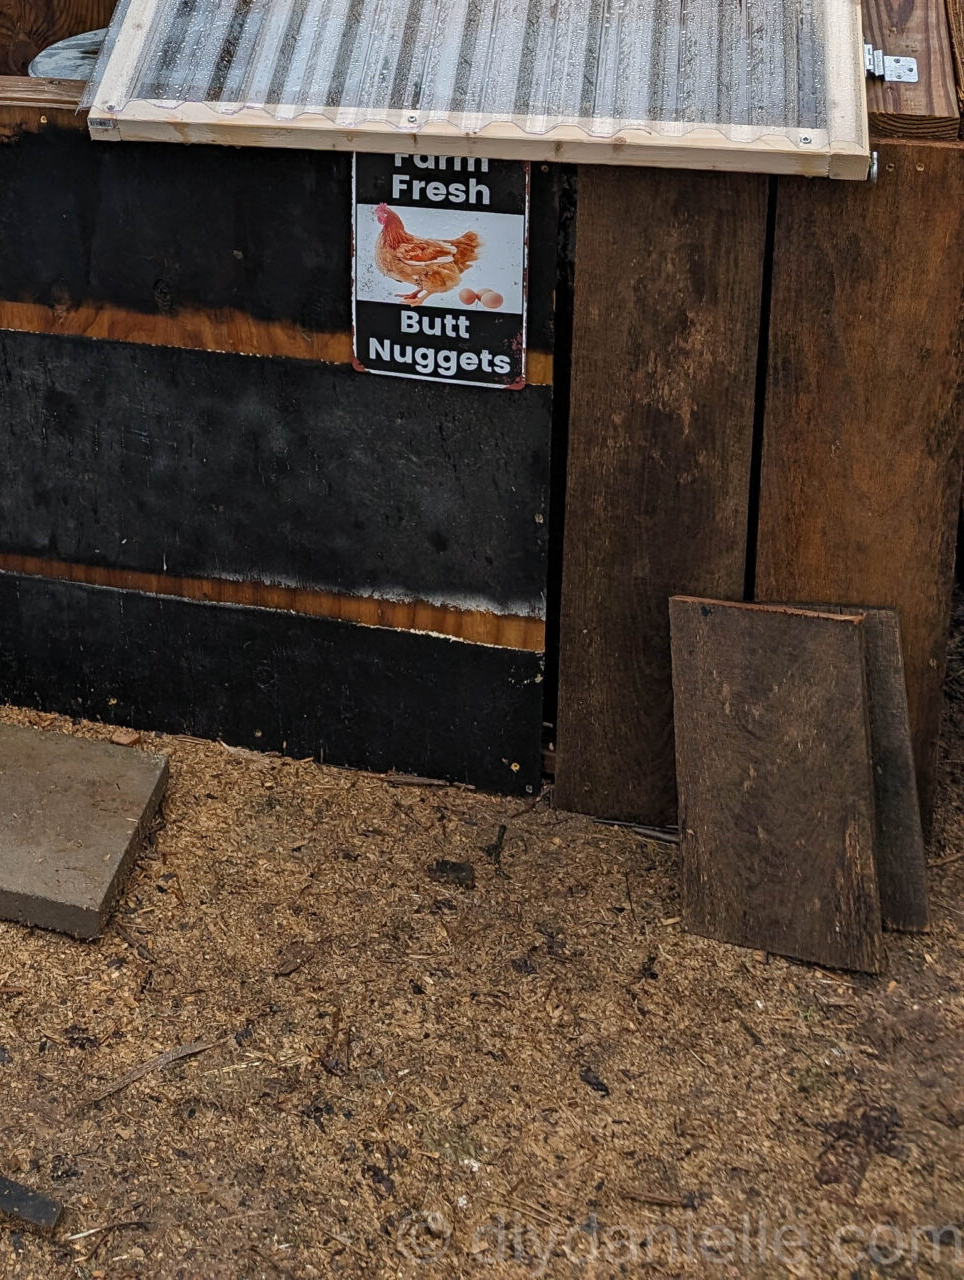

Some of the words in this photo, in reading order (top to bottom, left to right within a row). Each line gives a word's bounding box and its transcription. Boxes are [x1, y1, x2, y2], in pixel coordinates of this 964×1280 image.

[392, 174, 490, 205] Fresh
[400, 310, 470, 338] Butt
[369, 337, 511, 376] Nuggets
